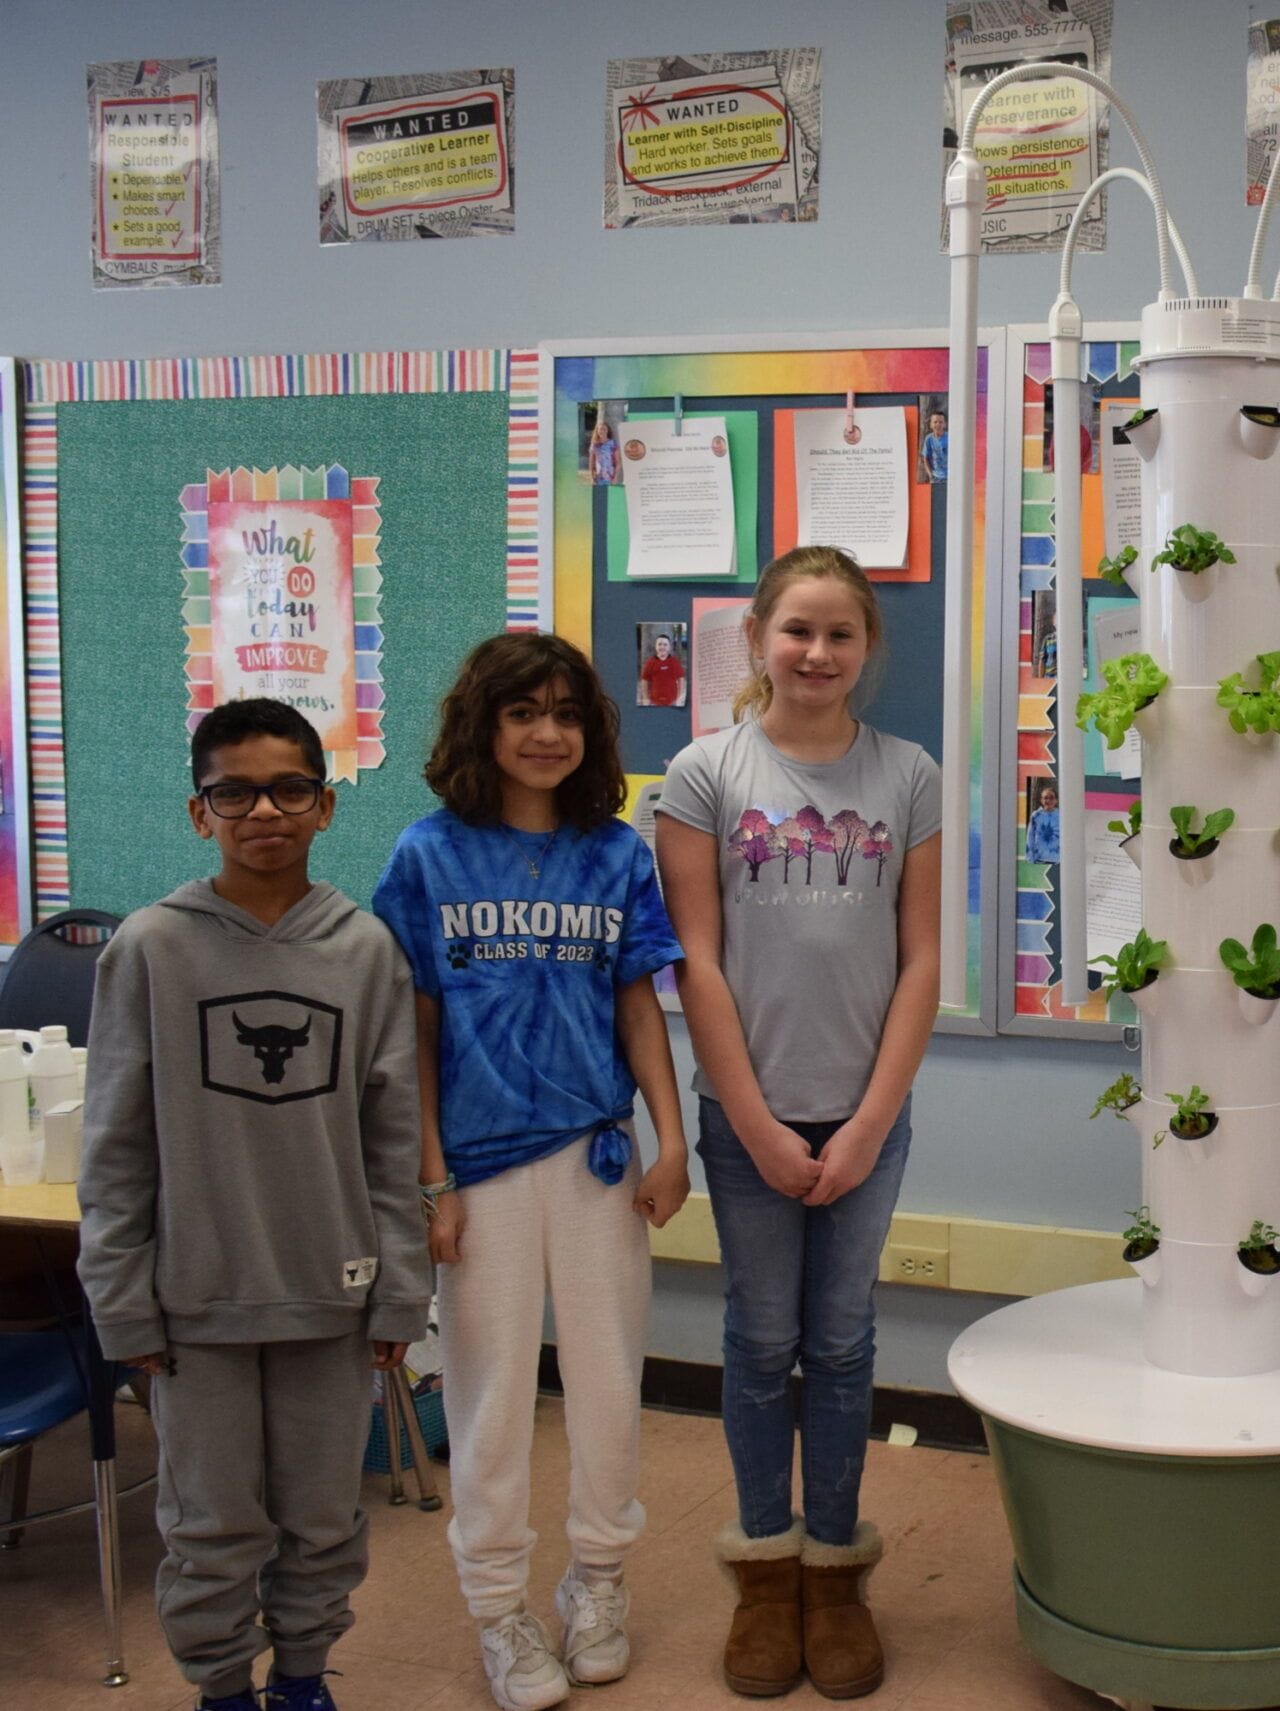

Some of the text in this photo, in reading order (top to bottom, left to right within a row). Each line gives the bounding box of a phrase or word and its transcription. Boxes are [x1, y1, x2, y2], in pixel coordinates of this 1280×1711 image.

[1024, 20, 1086, 41] 555-7777
[987, 86, 1075, 109] earner with
[104, 113, 194, 127] WANTED
[667, 99, 740, 121] WANTED
[977, 105, 1078, 127] Perseverance
[372, 111, 471, 141] WANTED
[108, 134, 190, 149] Responsible
[627, 132, 672, 149] Learner
[674, 126, 698, 143] with
[639, 131, 773, 163] Hard worker. Sets goals
[122, 153, 175, 168] Student
[356, 132, 491, 167] Cooperative Learner
[976, 145, 1008, 160] hows
[352, 168, 384, 187] Helps
[385, 161, 422, 179] others
[423, 158, 444, 173] and
[445, 156, 457, 169] is
[469, 150, 498, 166] team
[631, 164, 653, 180] and
[654, 158, 689, 176] works
[690, 155, 702, 170] to
[704, 149, 749, 168] achieve
[985, 157, 1072, 179] Determined in
[122, 173, 181, 186] Dependable.
[353, 166, 498, 204] player. Resolves conflicts.
[735, 176, 783, 196] external
[986, 178, 1069, 198] all situations.
[122, 189, 185, 202] Makes smart
[122, 205, 160, 217] choices.
[356, 217, 390, 235] DRUM
[458, 202, 495, 220] Oyster
[122, 221, 148, 233] Sets
[157, 221, 181, 236] good
[104, 261, 159, 275] CYMBALS
[242, 520, 316, 565] What
[290, 572, 313, 595] DO
[246, 588, 320, 632] today
[251, 623, 305, 639] CAN
[246, 646, 319, 668] IMPROVE
[257, 674, 311, 693] all your
[440, 900, 624, 944] NOKOMIS
[473, 942, 594, 962] CLASS OF 2023
